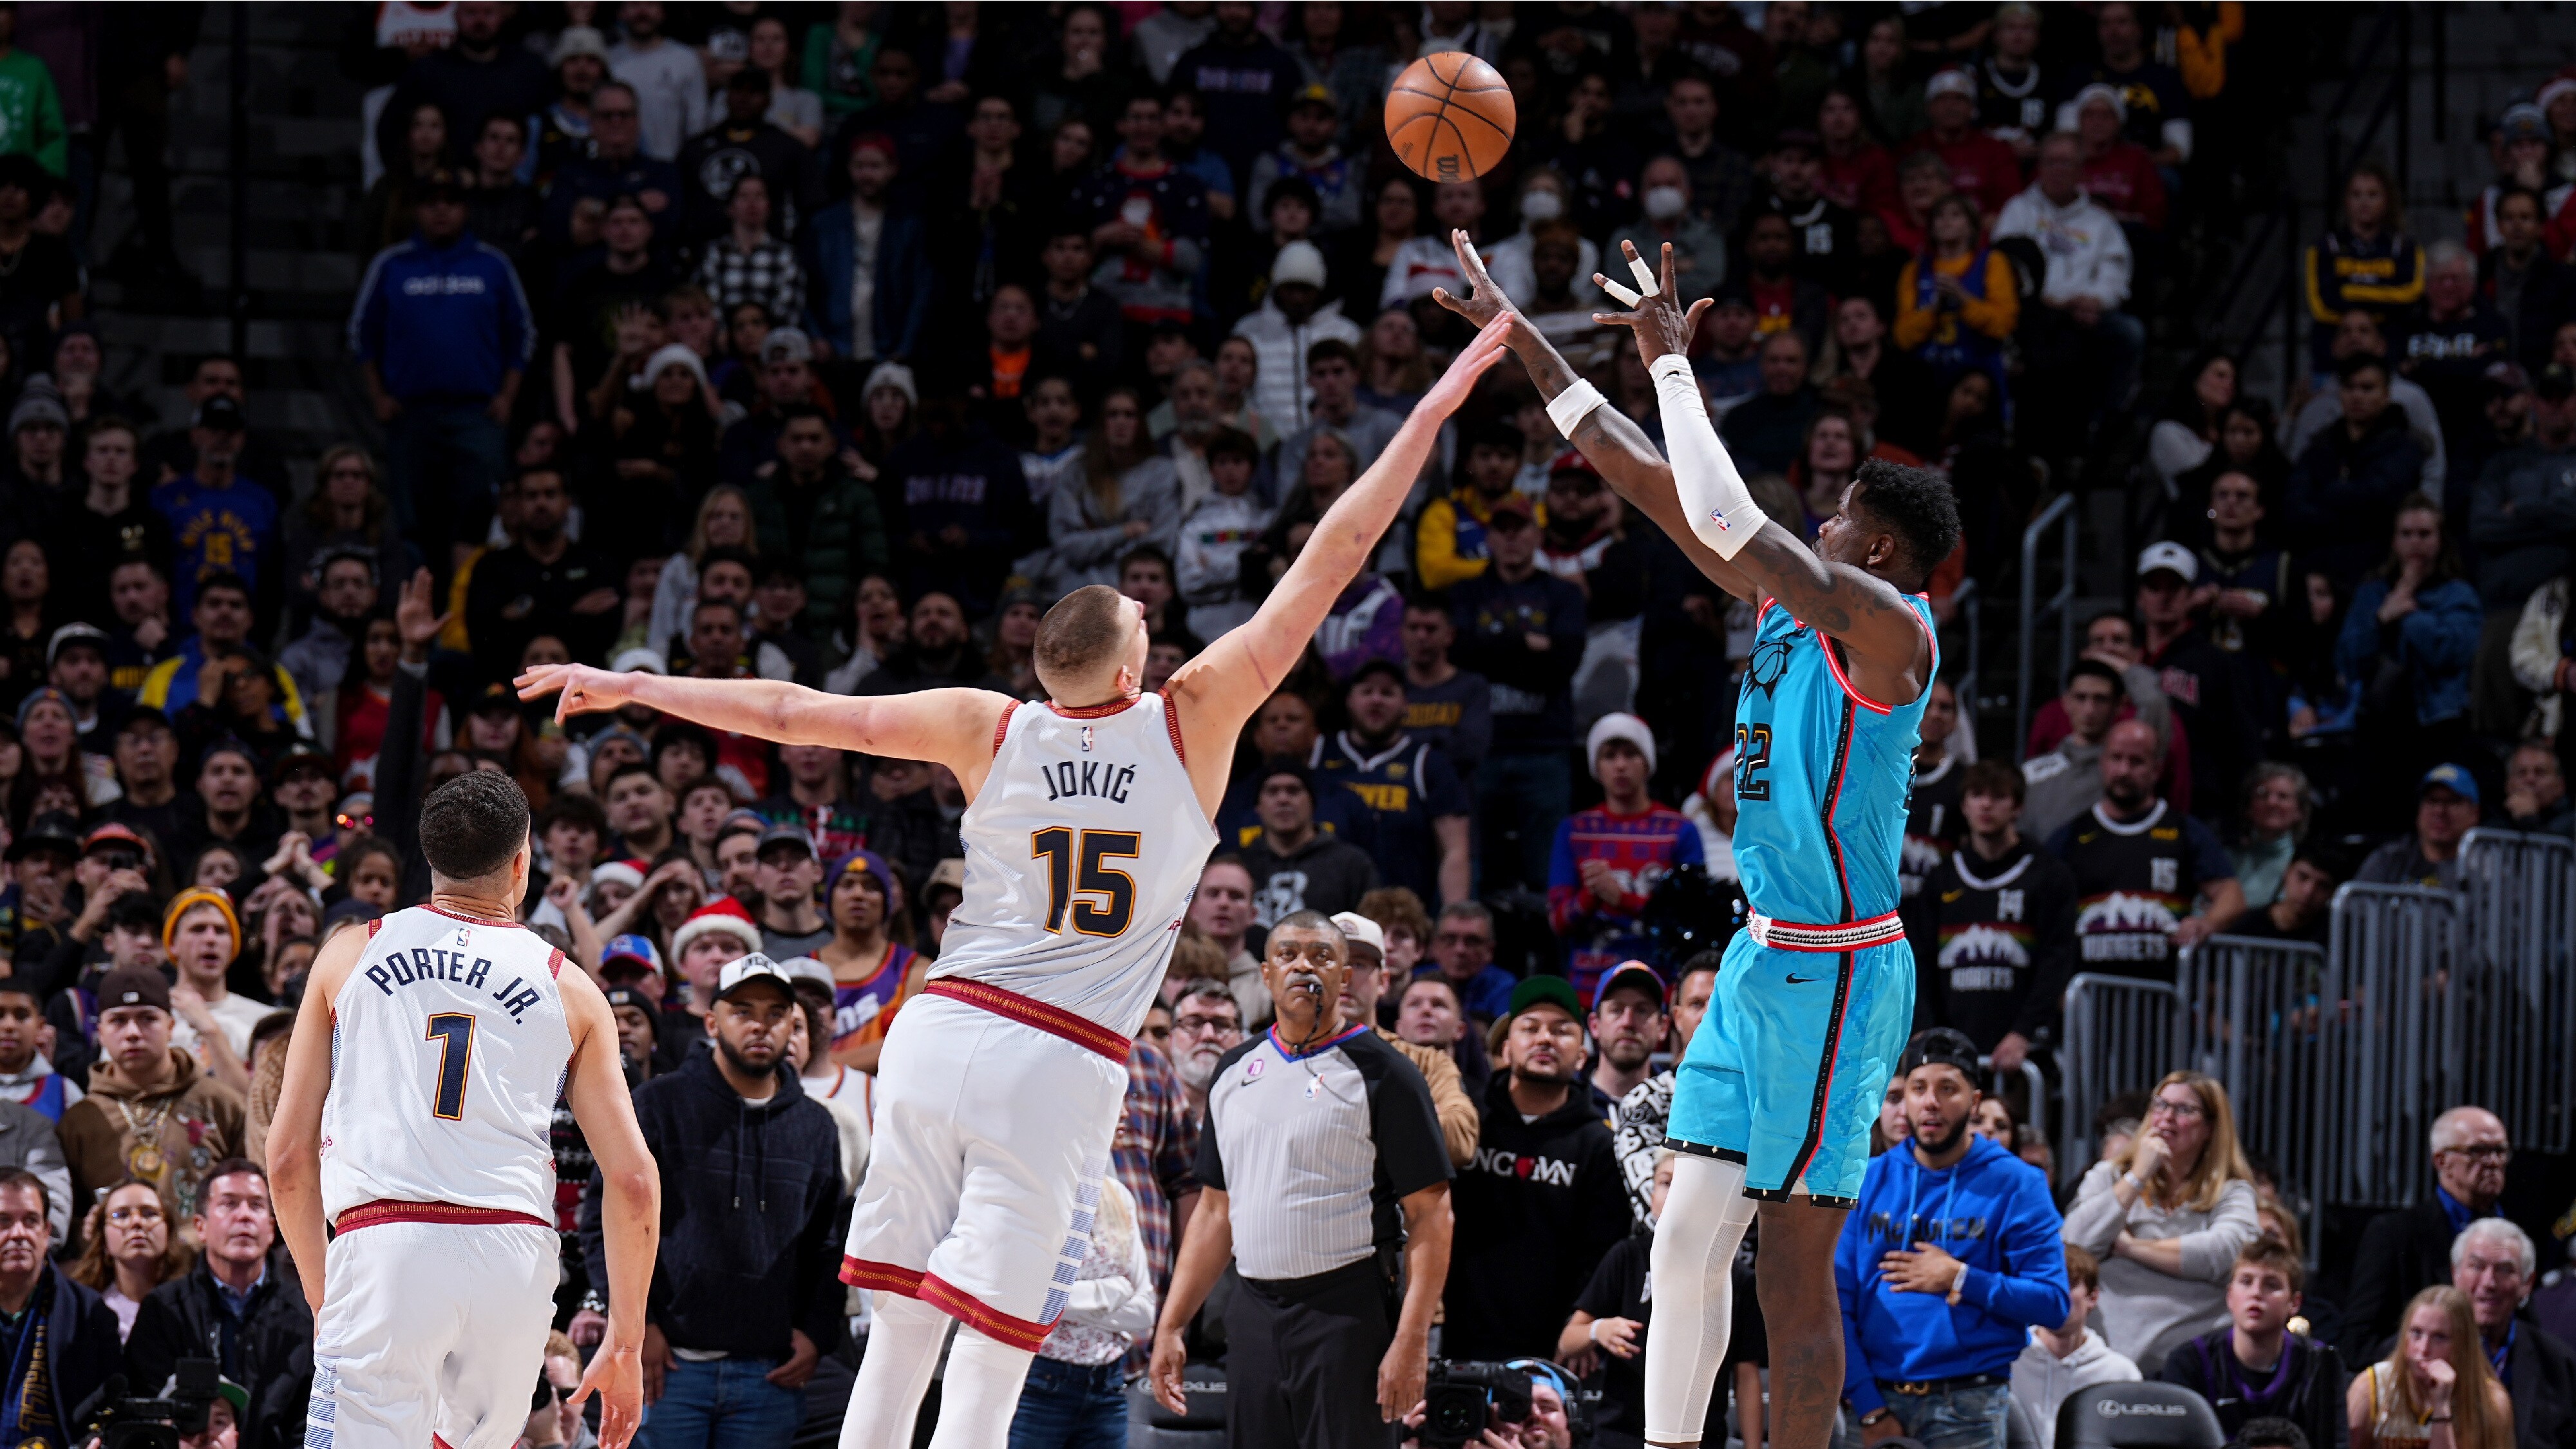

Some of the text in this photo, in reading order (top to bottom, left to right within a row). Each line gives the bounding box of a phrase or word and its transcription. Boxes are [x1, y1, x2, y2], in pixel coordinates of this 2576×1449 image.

[1041, 761, 1137, 804] JOKIĆ
[1735, 723, 1772, 801] 22
[1031, 826, 1141, 938] 15
[365, 948, 540, 1025] PORTER JR.
[426, 1012, 476, 1121] 1
[2121, 1403, 2188, 1417] LEXUS
